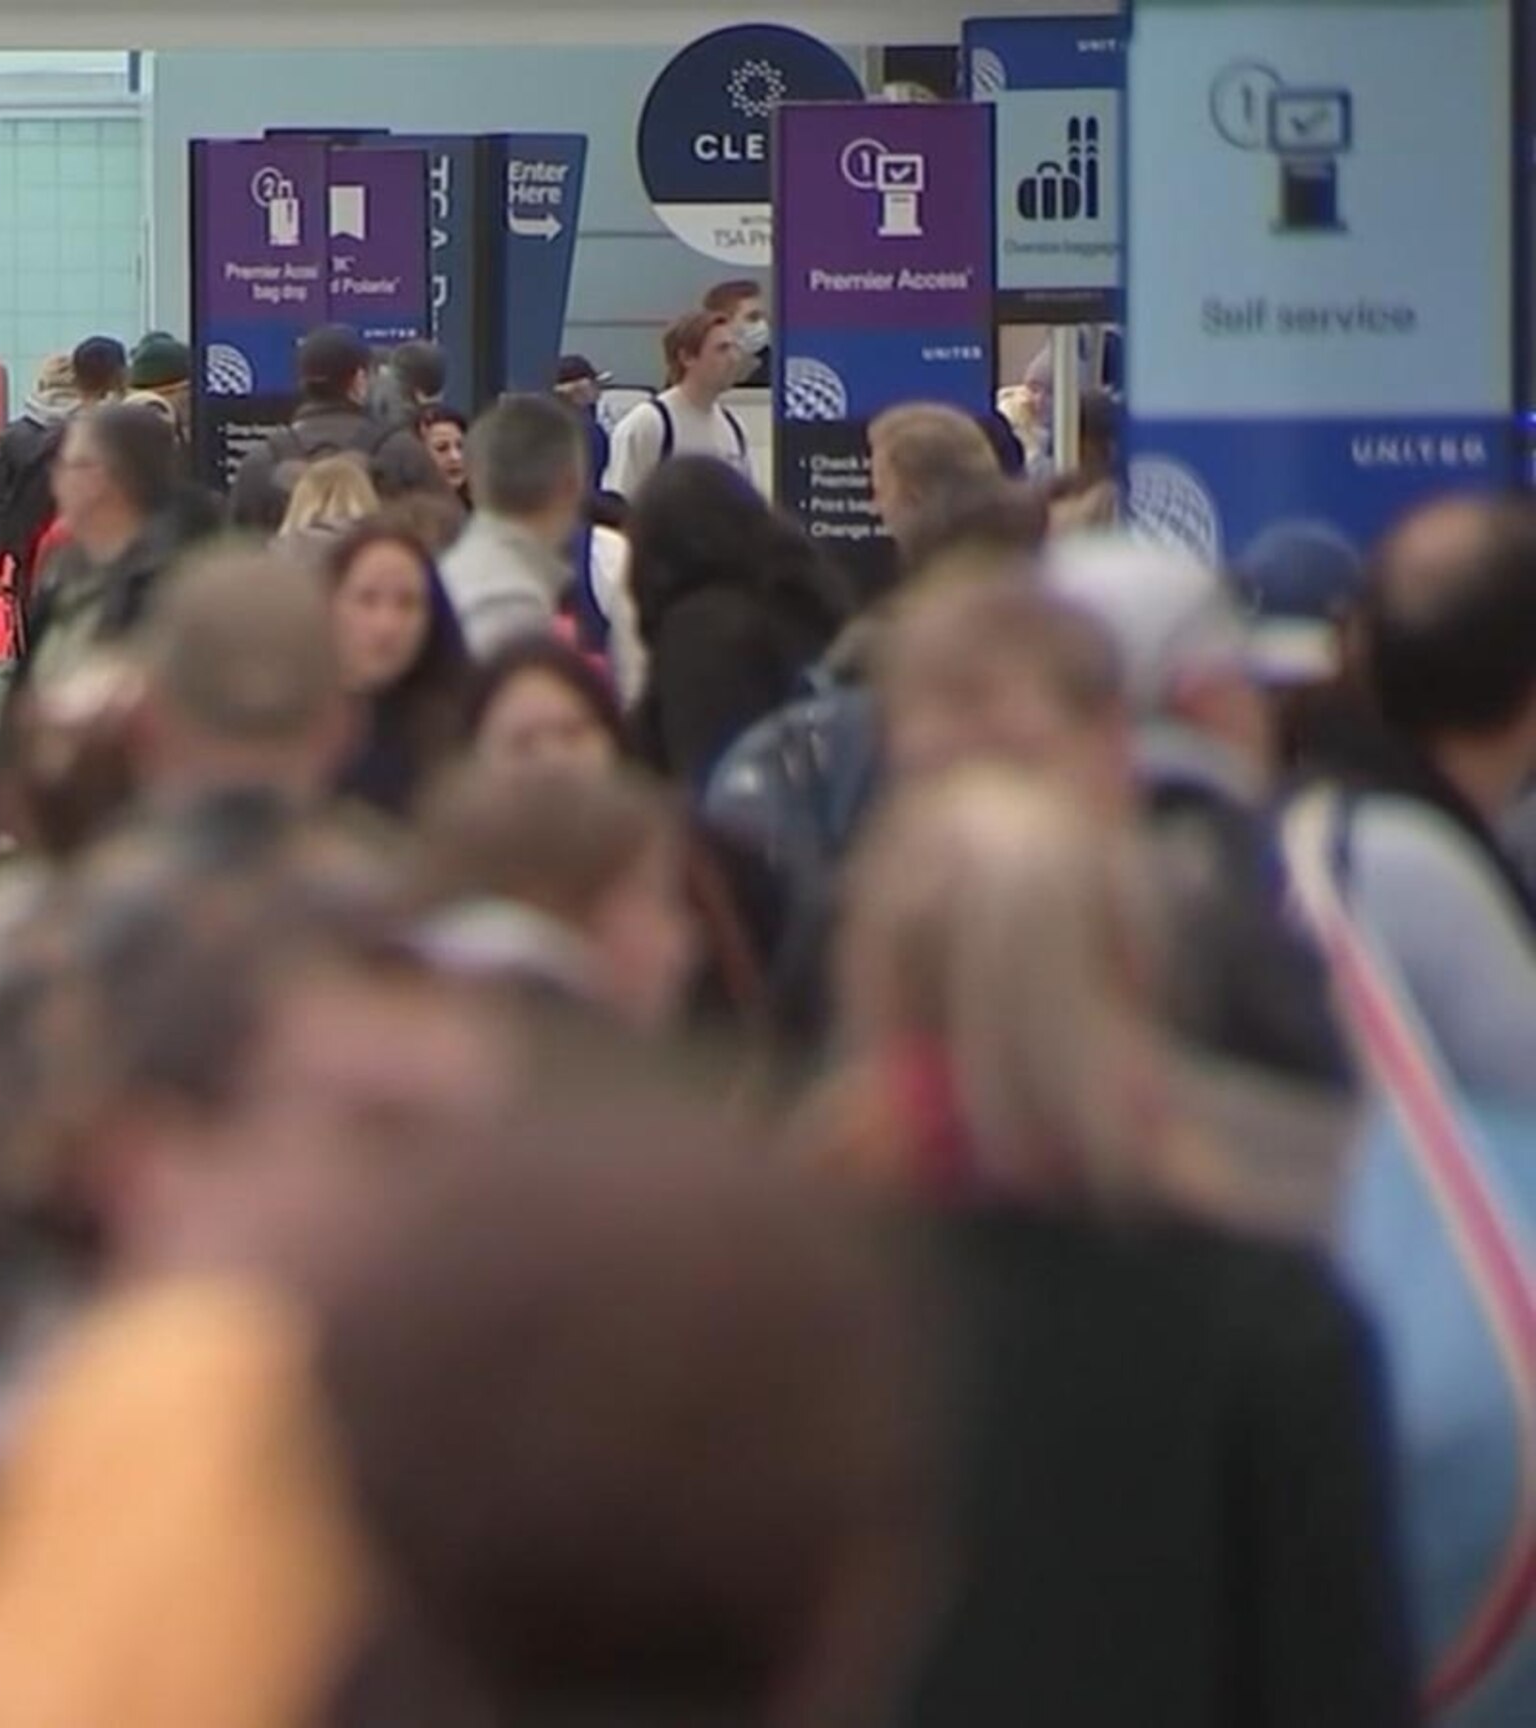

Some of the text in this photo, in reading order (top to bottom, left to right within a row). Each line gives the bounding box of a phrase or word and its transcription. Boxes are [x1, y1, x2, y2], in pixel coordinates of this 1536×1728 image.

[694, 133, 765, 161] CLE
[508, 160, 568, 182] Enter
[508, 183, 562, 205] Here
[749, 229, 772, 247] Pr
[224, 262, 281, 281] Premier
[809, 268, 970, 291] Premier Access
[1201, 297, 1418, 336] Self service
[1351, 433, 1486, 470] UNITED
[810, 455, 858, 471] Check
[810, 497, 844, 513] Print
[810, 521, 871, 541] Change
